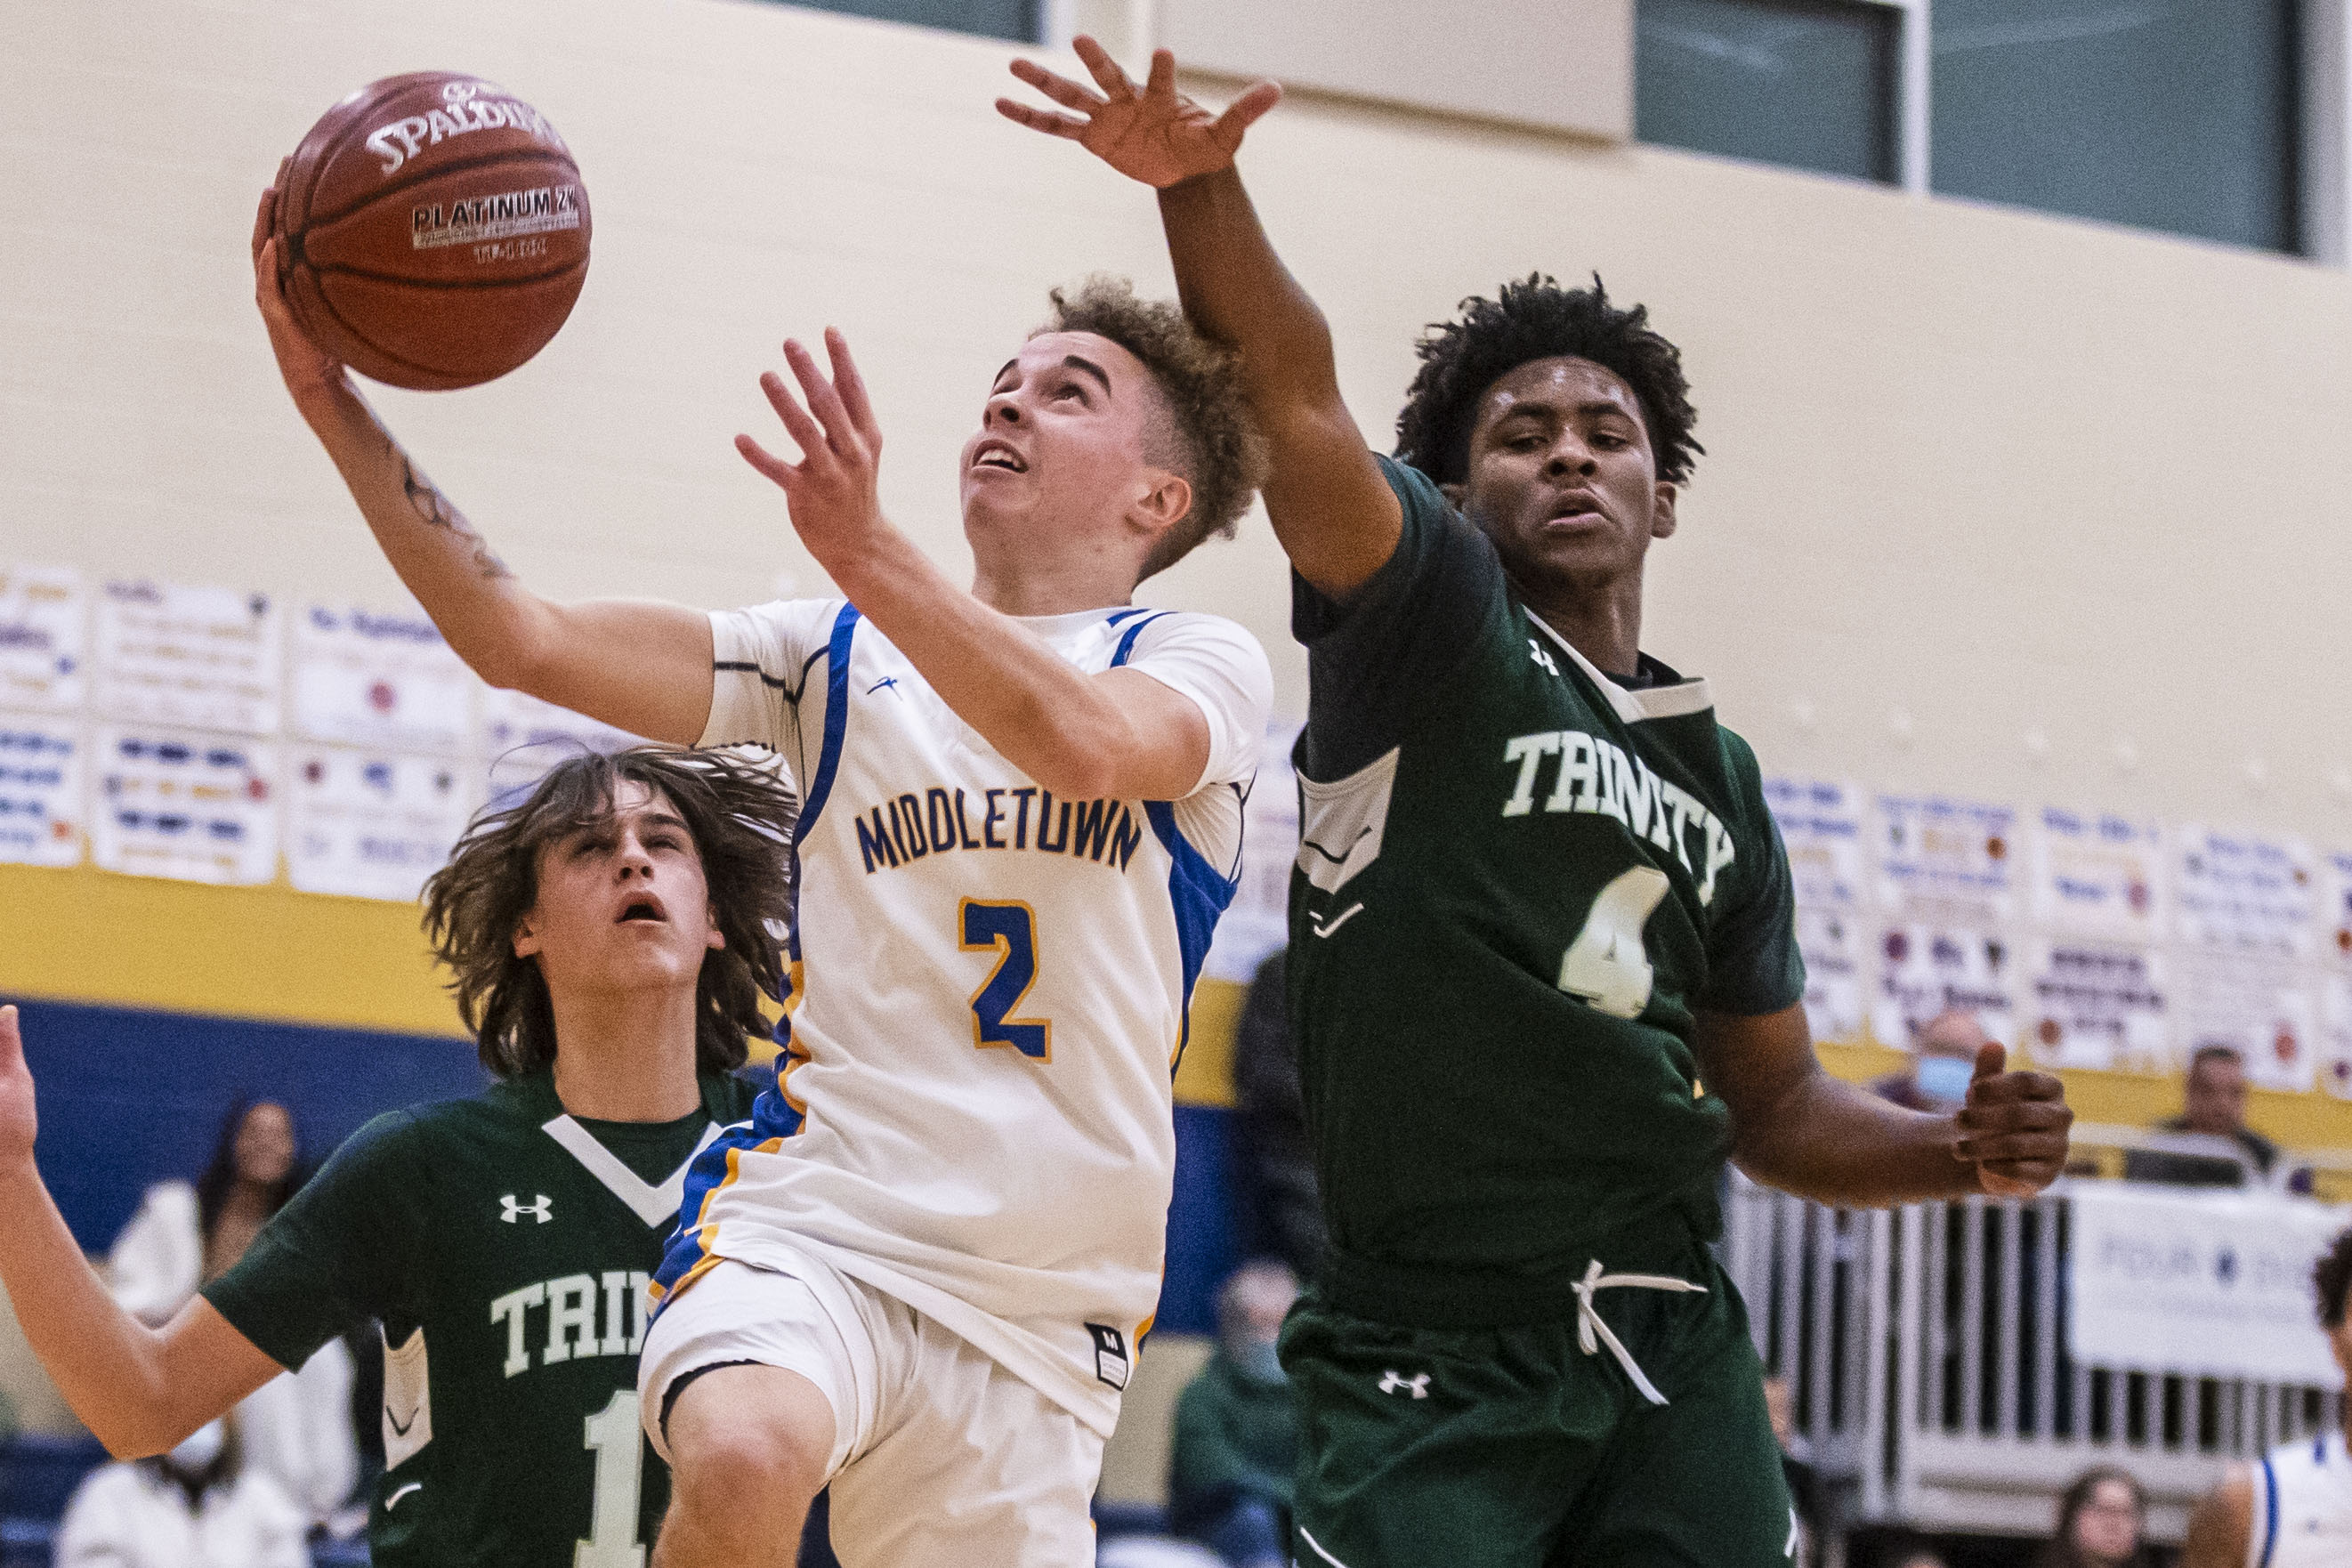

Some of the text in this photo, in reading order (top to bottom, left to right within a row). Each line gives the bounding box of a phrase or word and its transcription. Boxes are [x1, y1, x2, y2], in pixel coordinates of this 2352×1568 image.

[413, 187, 550, 233] PLATINUM
[854, 785, 1143, 876] MIDDLETOWN
[1502, 730, 1735, 908] TRINITY
[958, 895, 1052, 1064] 2
[1557, 864, 1671, 1020] 4
[572, 1389, 647, 1568] 1
